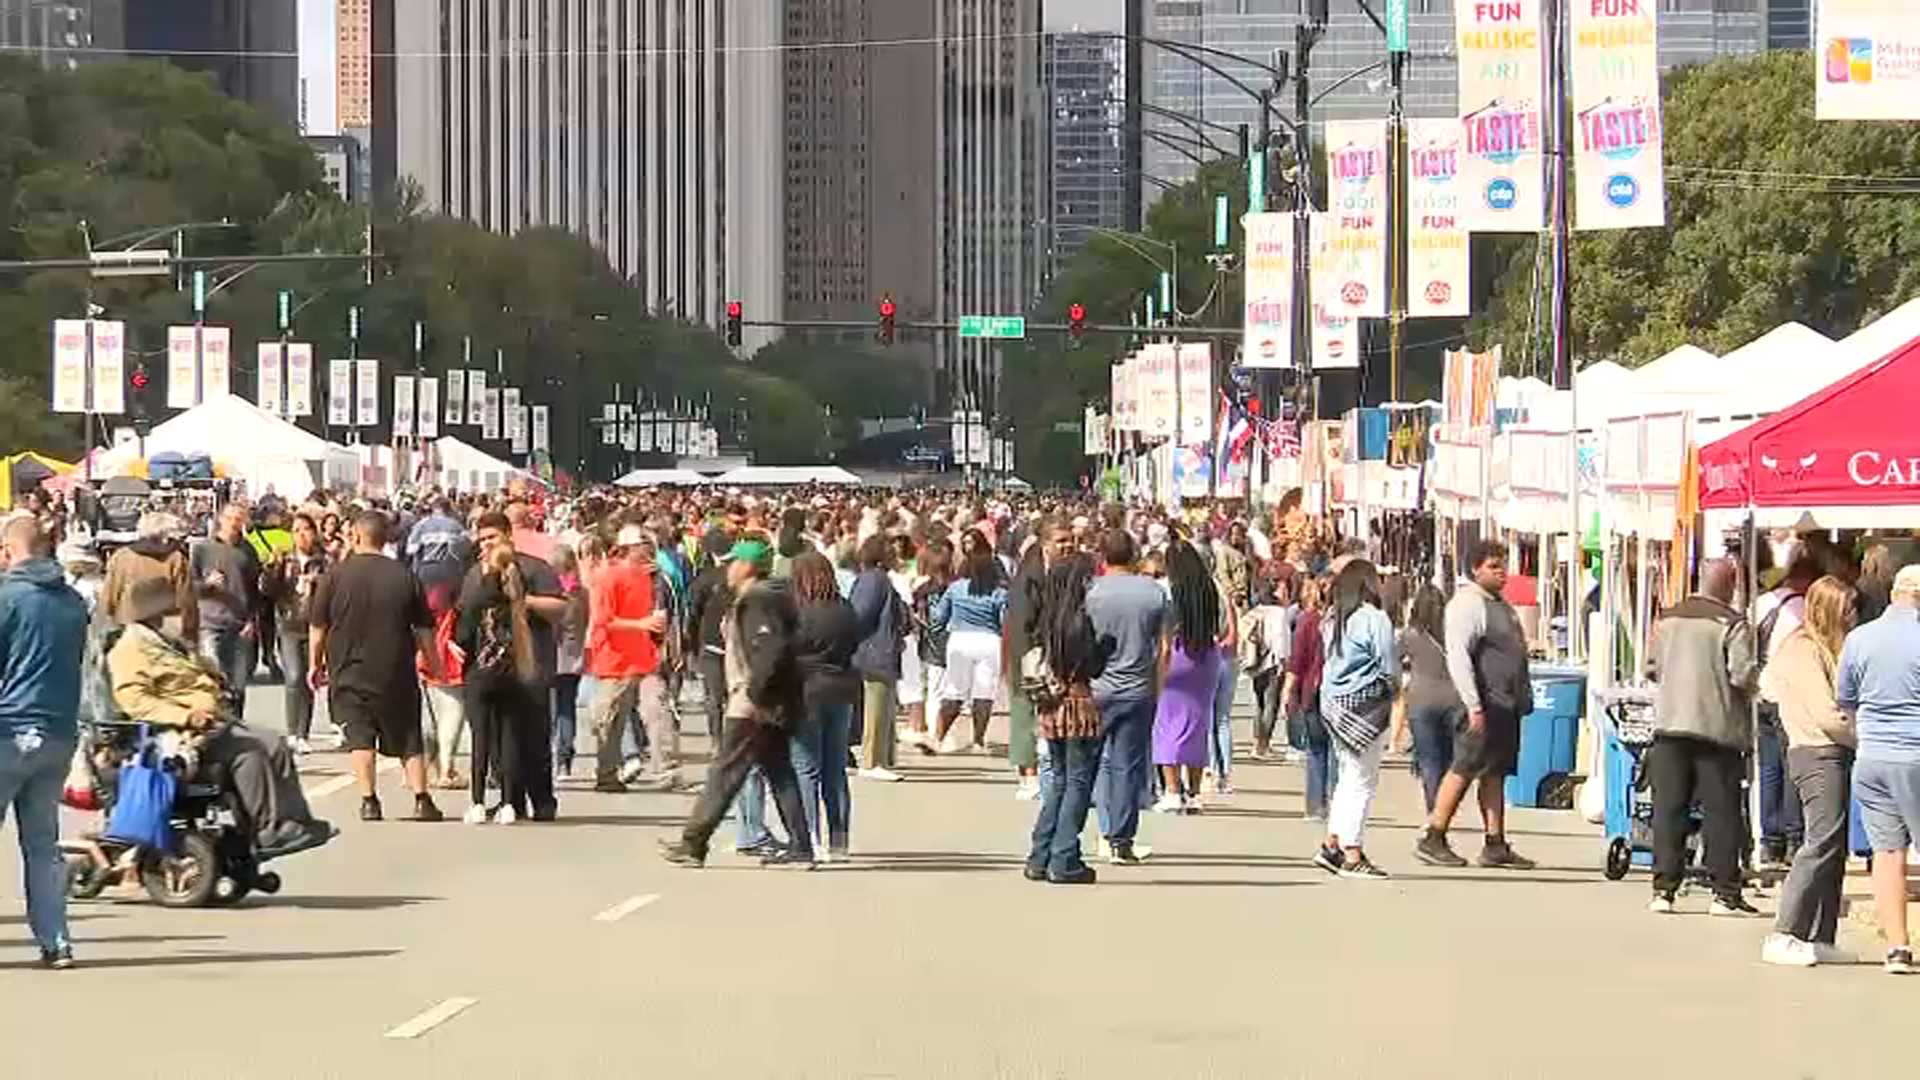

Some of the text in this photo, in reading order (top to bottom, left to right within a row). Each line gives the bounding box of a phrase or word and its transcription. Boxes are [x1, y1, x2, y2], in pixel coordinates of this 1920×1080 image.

[1475, 3, 1521, 21] FUN
[1590, 0, 1640, 17] FUN
[1461, 30, 1536, 49] MUSIC
[1463, 112, 1527, 154] TASTE
[1577, 108, 1647, 152] TASTE
[1342, 216, 1373, 229] FUN
[1422, 216, 1455, 229] FUN
